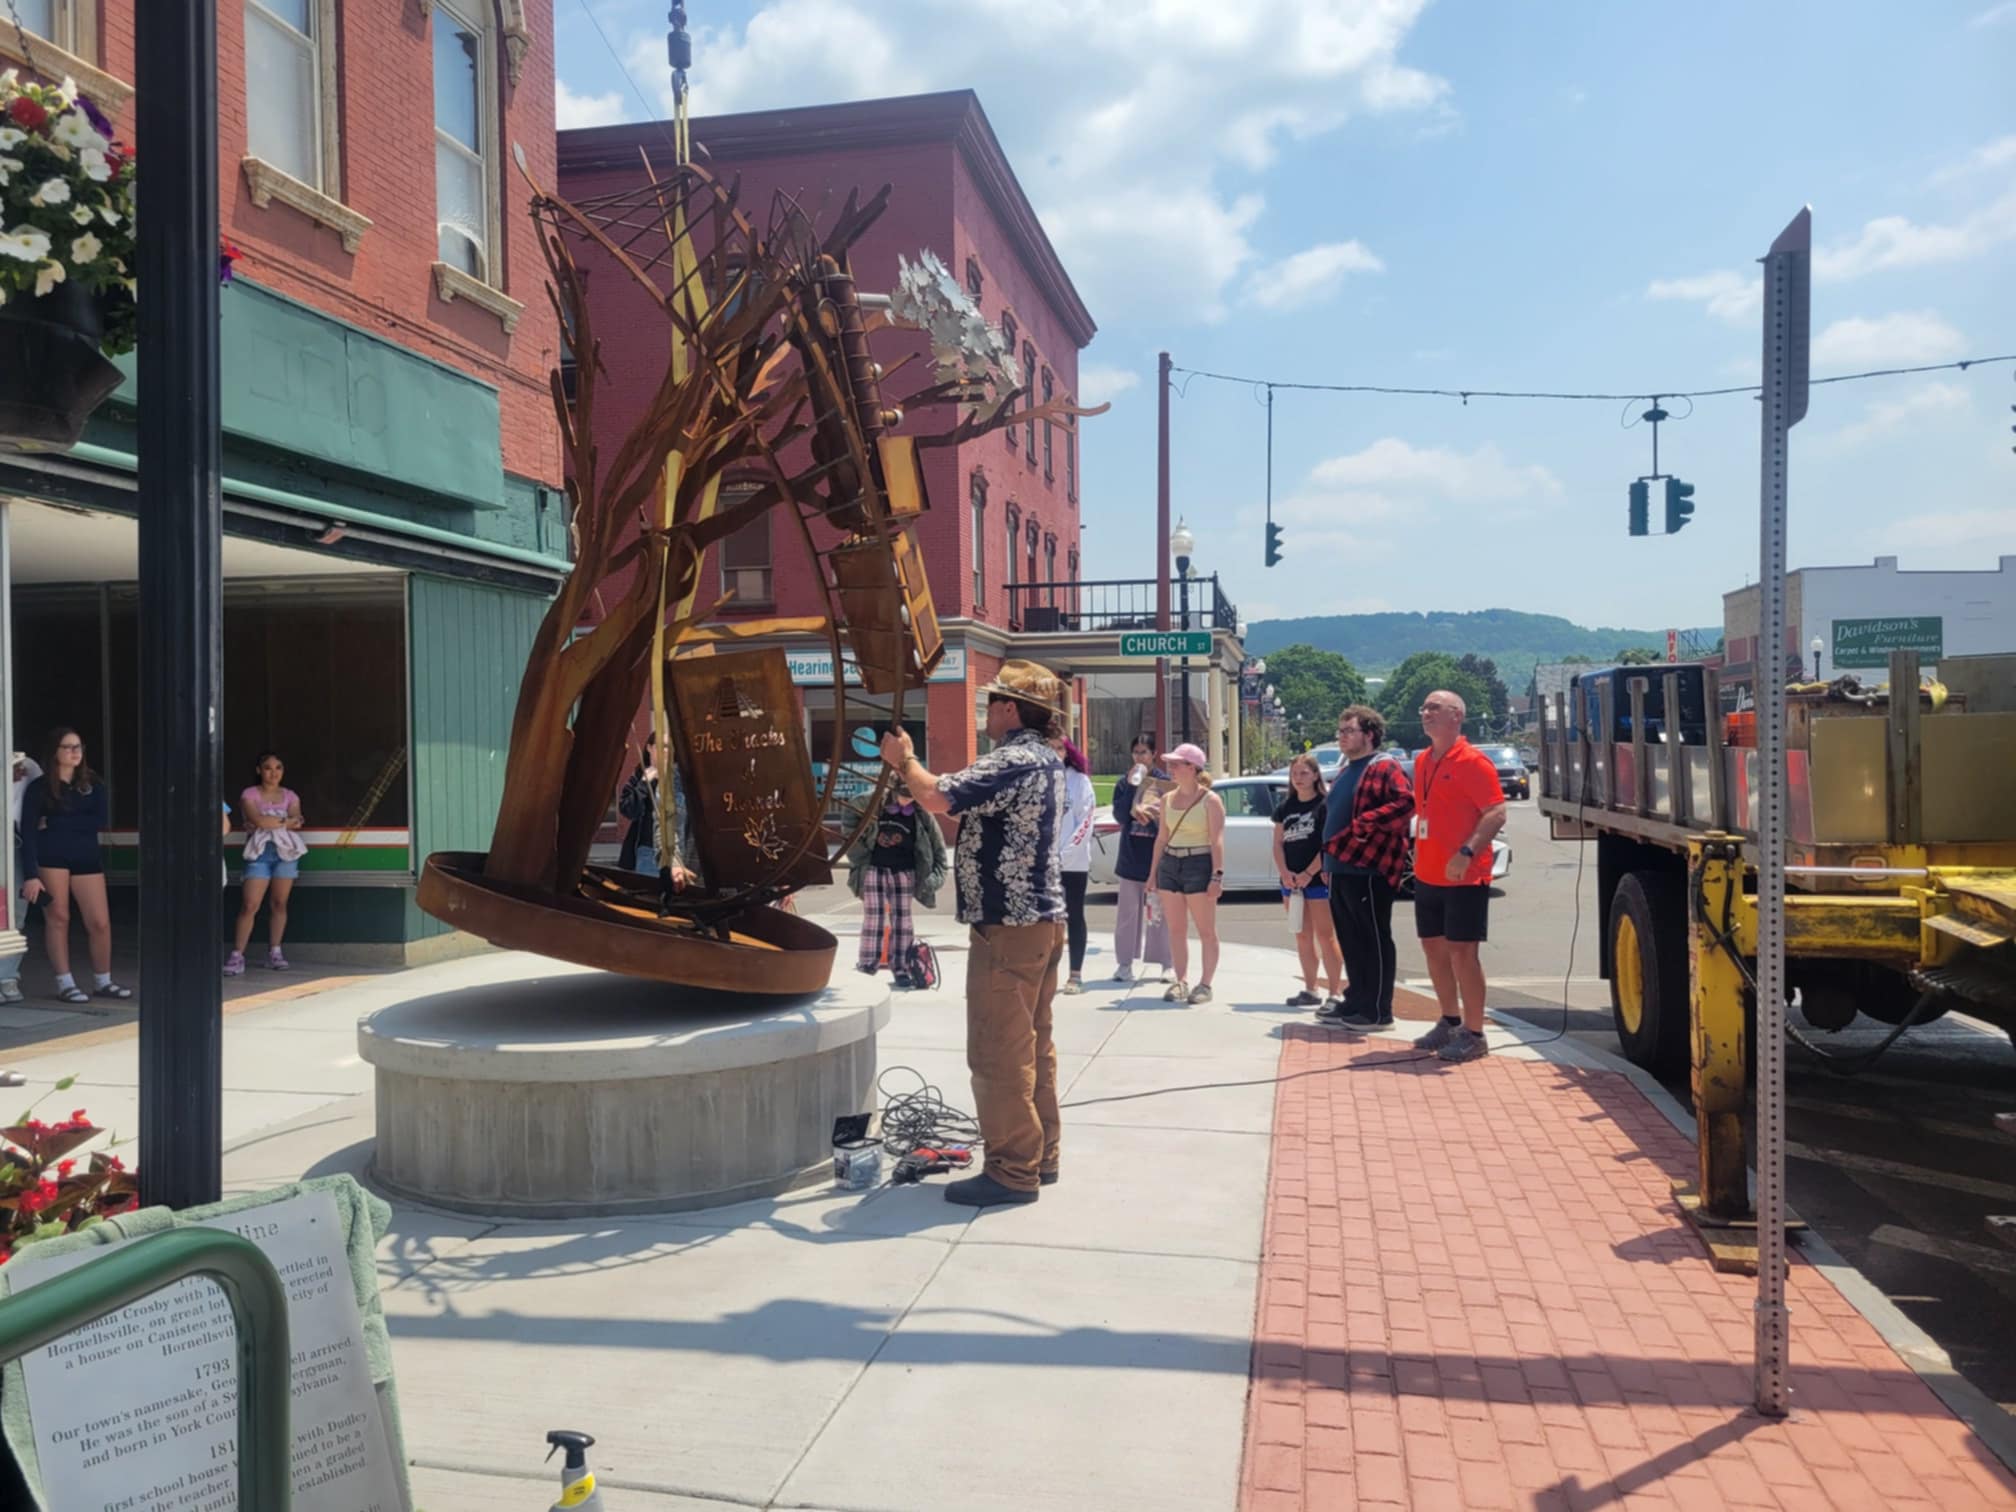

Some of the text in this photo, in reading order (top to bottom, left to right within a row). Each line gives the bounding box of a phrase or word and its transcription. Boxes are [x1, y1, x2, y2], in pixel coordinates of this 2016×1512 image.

[1836, 618, 1919, 642] Davidson's
[1874, 633, 1940, 644] Furniture
[1126, 637, 1187, 652] CHURCH
[279, 1255, 329, 1277] ettled in
[289, 1266, 334, 1288] erected
[122, 1298, 170, 1321] Crosby
[173, 1288, 203, 1305] with
[292, 1283, 329, 1302] city of
[47, 1298, 226, 1359] Hornellsville, on great lot
[64, 1360, 74, 1370] a
[78, 1346, 122, 1366] house
[126, 1340, 144, 1351] on
[148, 1320, 208, 1344] Canisteo
[162, 1325, 235, 1357] Hornellsvil
[195, 1358, 231, 1379] 1793
[291, 1356, 347, 1380] ergyman,
[51, 1376, 238, 1445] Our town's namesake, Geo
[80, 1437, 100, 1453] He
[104, 1428, 133, 1444] was
[137, 1416, 161, 1433] the
[165, 1408, 190, 1424] son
[193, 1399, 208, 1413] of
[211, 1400, 219, 1410] a
[296, 1412, 367, 1443] with Dudley
[82, 1450, 111, 1469] and
[114, 1438, 149, 1457] born
[153, 1430, 167, 1445] in
[170, 1418, 202, 1438] York
[209, 1438, 236, 1460] 181
[321, 1440, 334, 1451] to
[336, 1433, 351, 1445] be
[354, 1430, 361, 1439] a
[315, 1461, 322, 1470] a
[325, 1441, 366, 1468] graded
[103, 1496, 134, 1512] first
[138, 1476, 185, 1503] school
[187, 1462, 228, 1485] house
[204, 1490, 237, 1512] until
